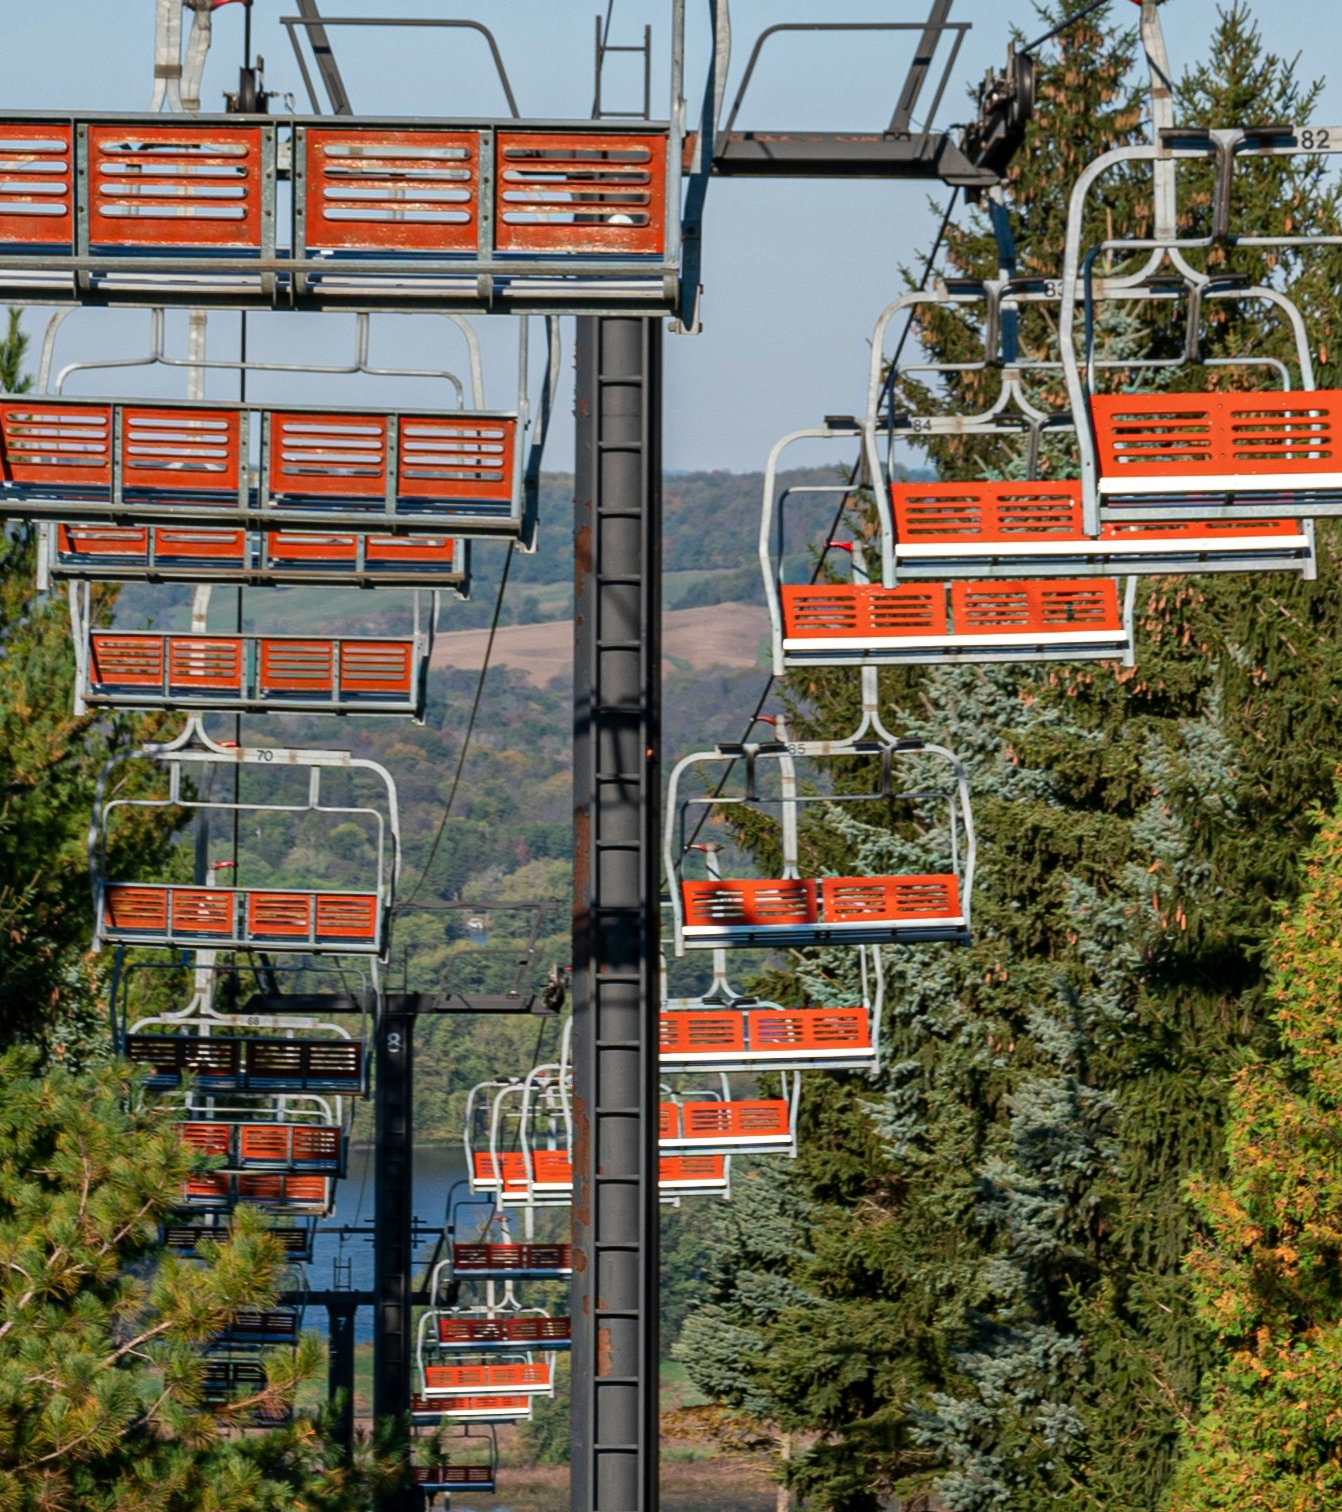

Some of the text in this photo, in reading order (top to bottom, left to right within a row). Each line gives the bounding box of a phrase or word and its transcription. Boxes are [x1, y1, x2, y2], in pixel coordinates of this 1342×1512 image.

[1301, 129, 1330, 150] 82
[913, 419, 932, 433] 84
[256, 749, 274, 762] 70
[387, 1032, 401, 1053] 8
